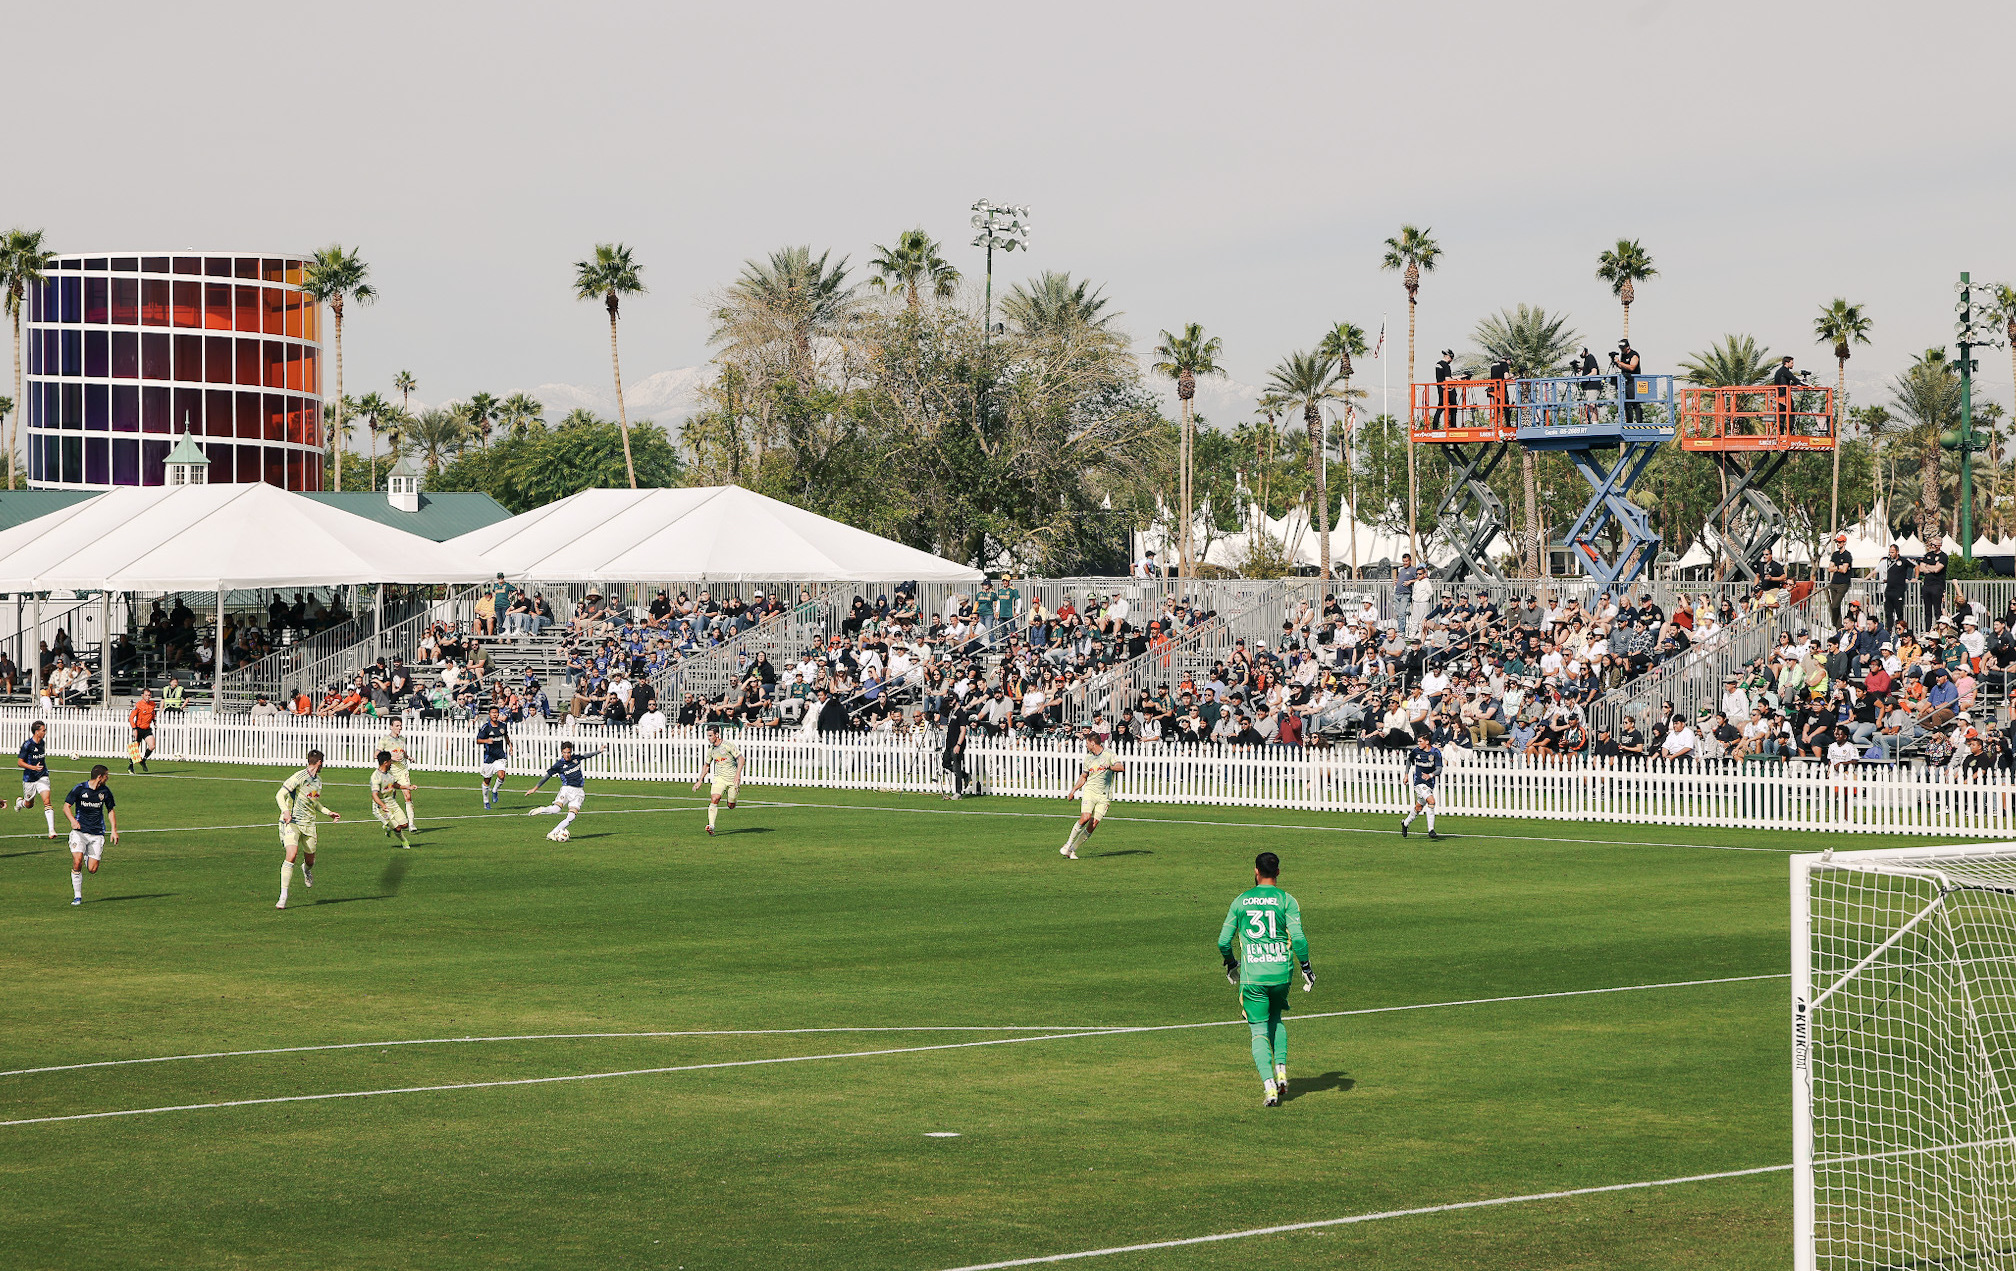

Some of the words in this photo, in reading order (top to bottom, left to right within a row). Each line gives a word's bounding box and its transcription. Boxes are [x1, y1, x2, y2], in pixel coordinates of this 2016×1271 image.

[1243, 897, 1279, 906] CORONEL
[1246, 910, 1277, 939] 31
[1248, 955, 1266, 964] Red
[1266, 954, 1287, 963] Bulls
